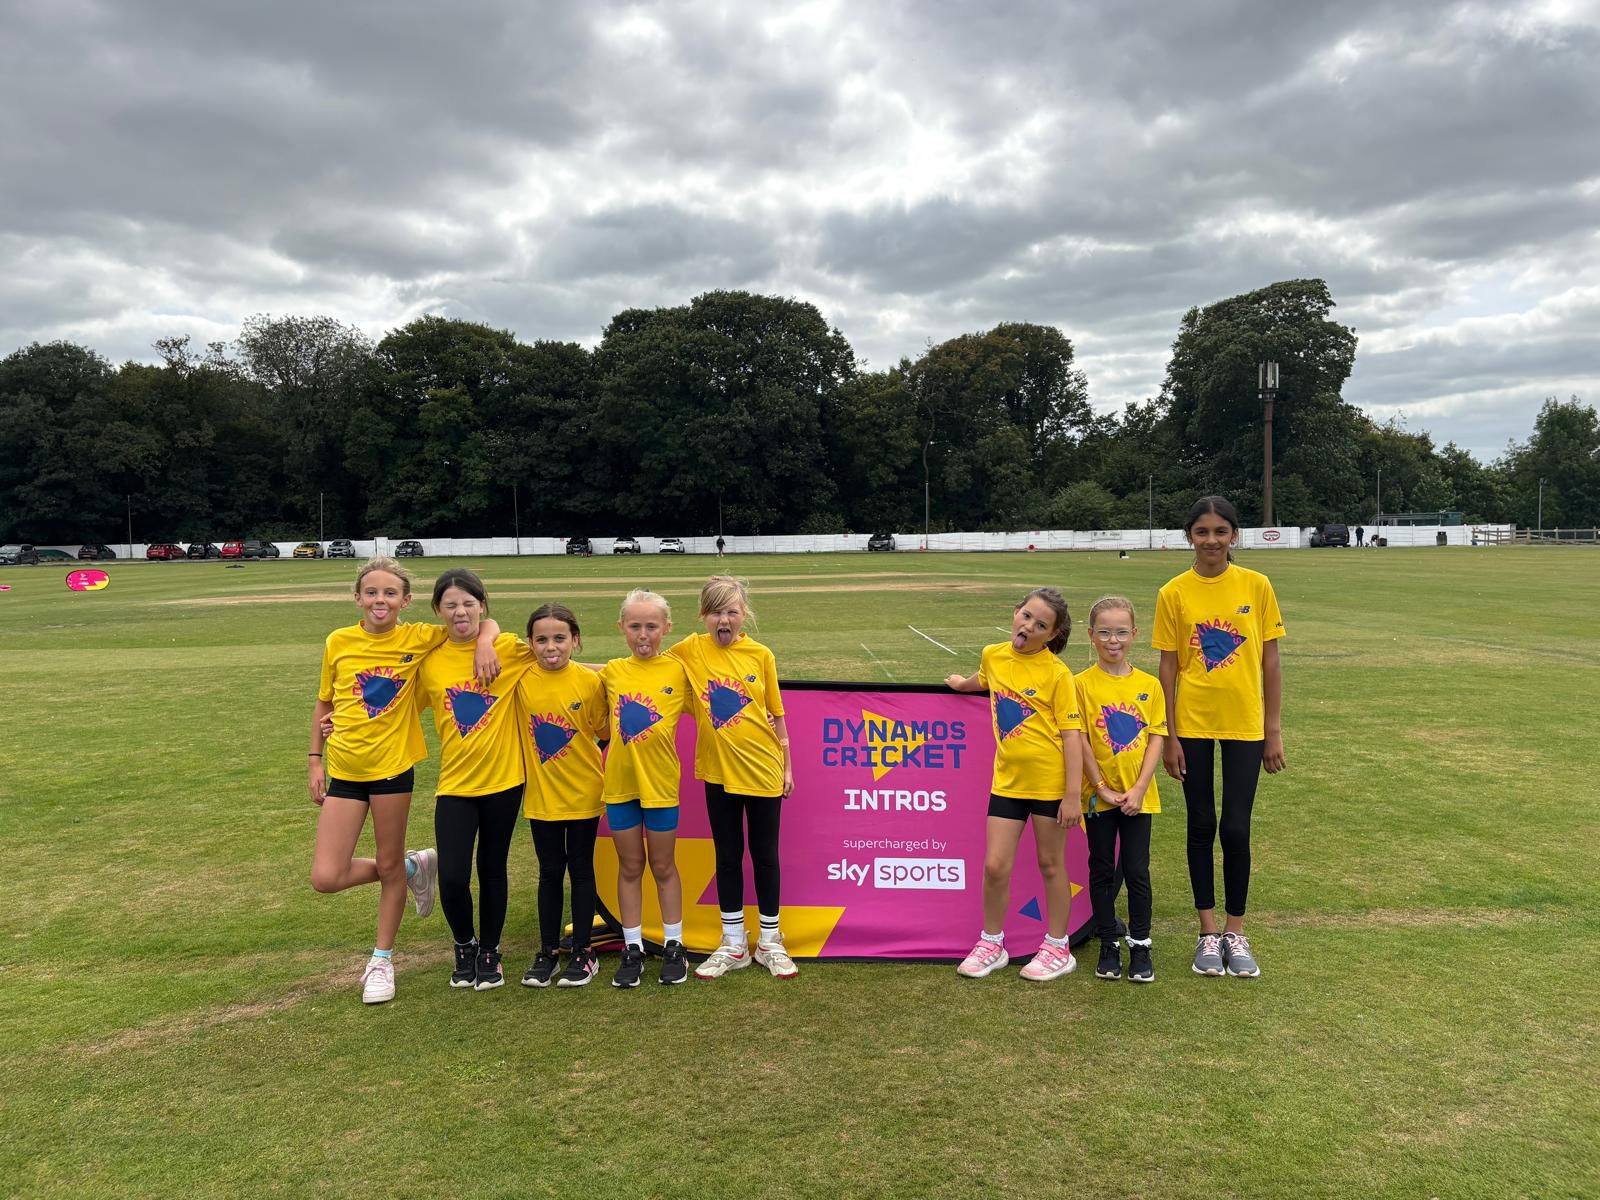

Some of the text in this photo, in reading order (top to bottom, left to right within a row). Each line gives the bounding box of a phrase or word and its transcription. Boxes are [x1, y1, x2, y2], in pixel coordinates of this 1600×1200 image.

[823, 718, 966, 744] DYNAMOS
[822, 743, 967, 769] CRICKET
[843, 789, 947, 812] INTROS
[843, 838, 947, 852] supercharged by
[827, 858, 960, 887] sky sports
